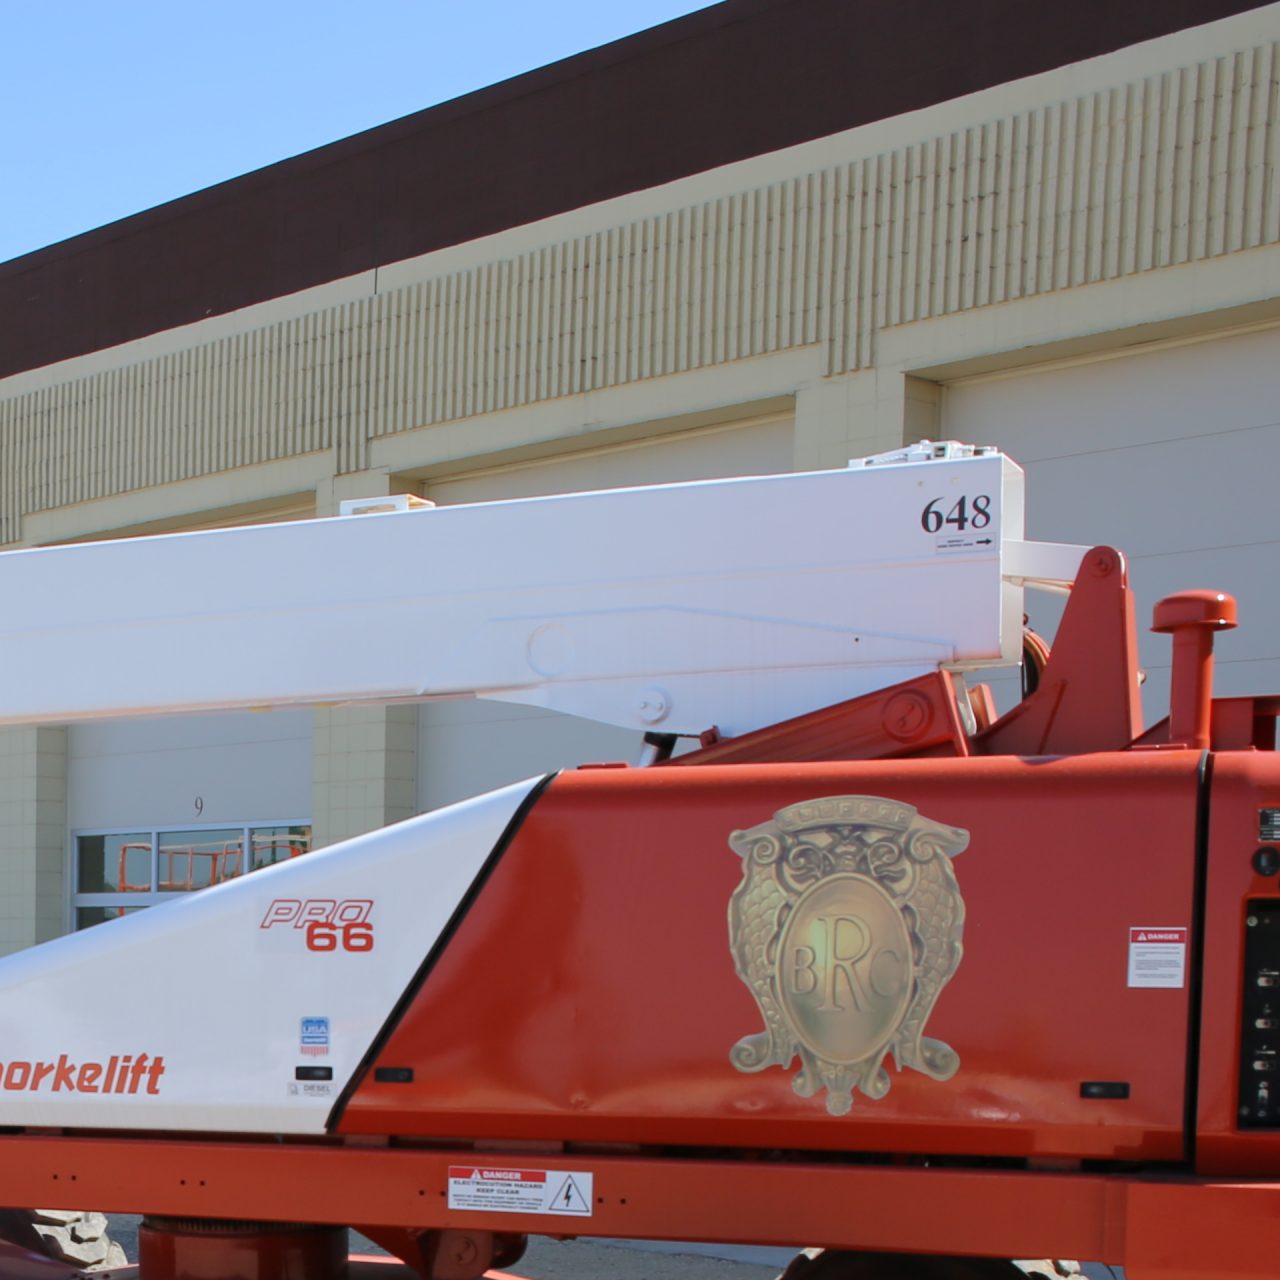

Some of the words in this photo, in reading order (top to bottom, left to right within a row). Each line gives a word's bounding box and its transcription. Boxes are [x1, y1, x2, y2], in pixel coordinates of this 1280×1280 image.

[921, 495, 991, 533] 648
[195, 796, 203, 817] 9
[260, 899, 373, 929] PRO
[306, 922, 374, 952] 66
[482, 1171, 521, 1180] DANGER
